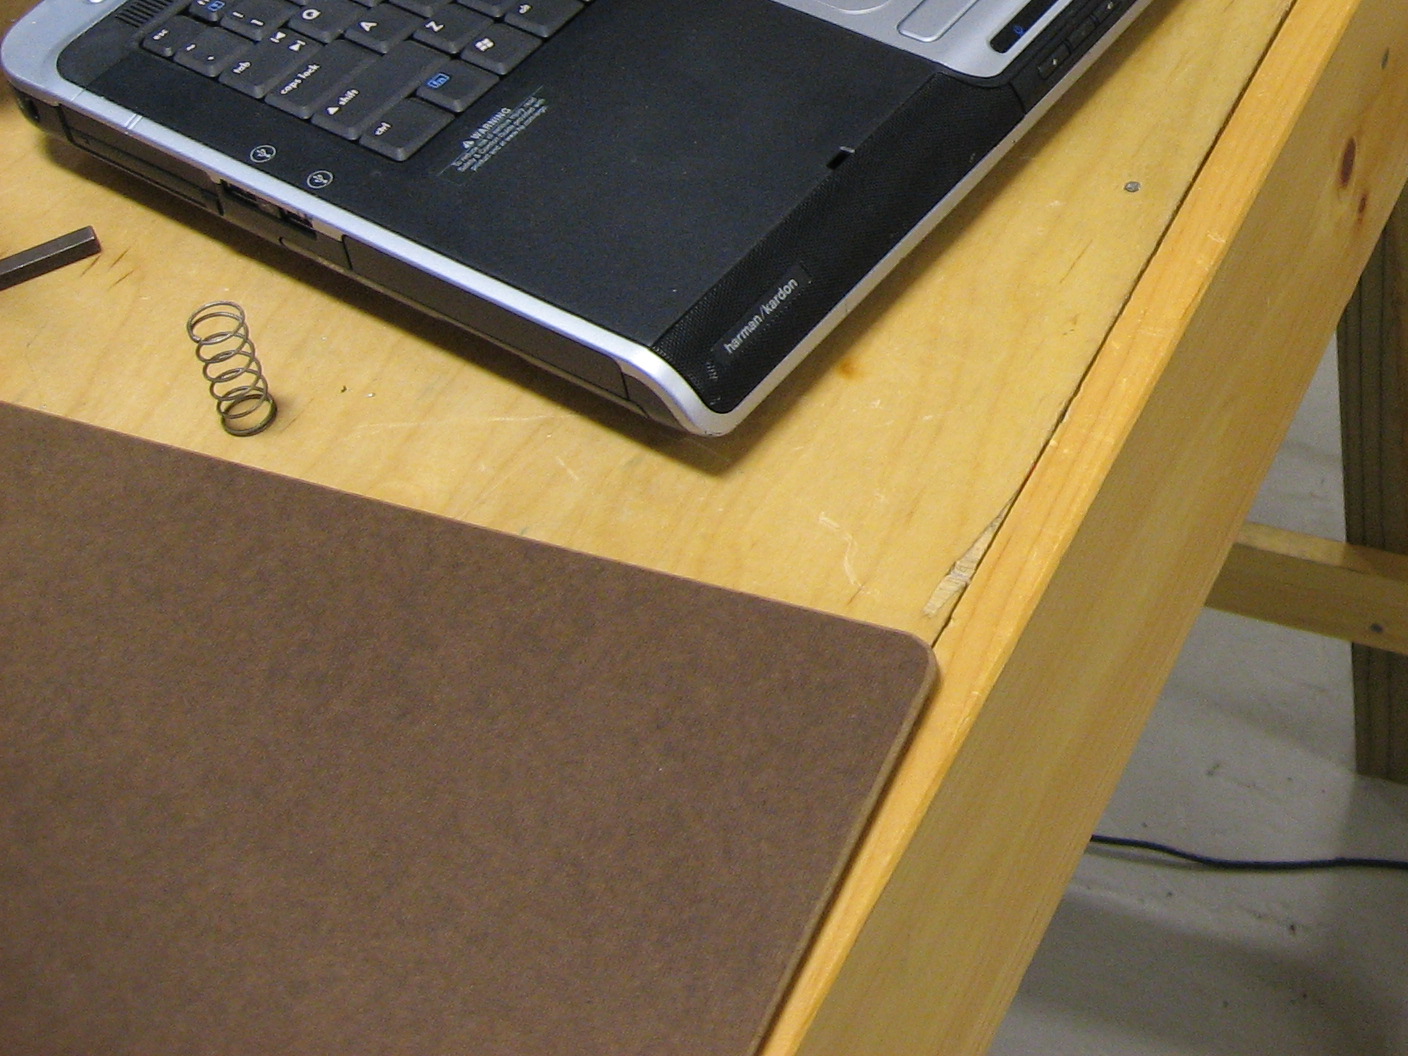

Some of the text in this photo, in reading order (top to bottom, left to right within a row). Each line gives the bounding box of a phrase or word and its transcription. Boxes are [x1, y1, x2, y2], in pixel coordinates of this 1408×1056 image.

[302, 8, 321, 20] Q
[360, 21, 377, 32] A
[424, 20, 444, 32] Z
[297, 63, 320, 79] lock
[724, 277, 799, 354] harman/kardon
